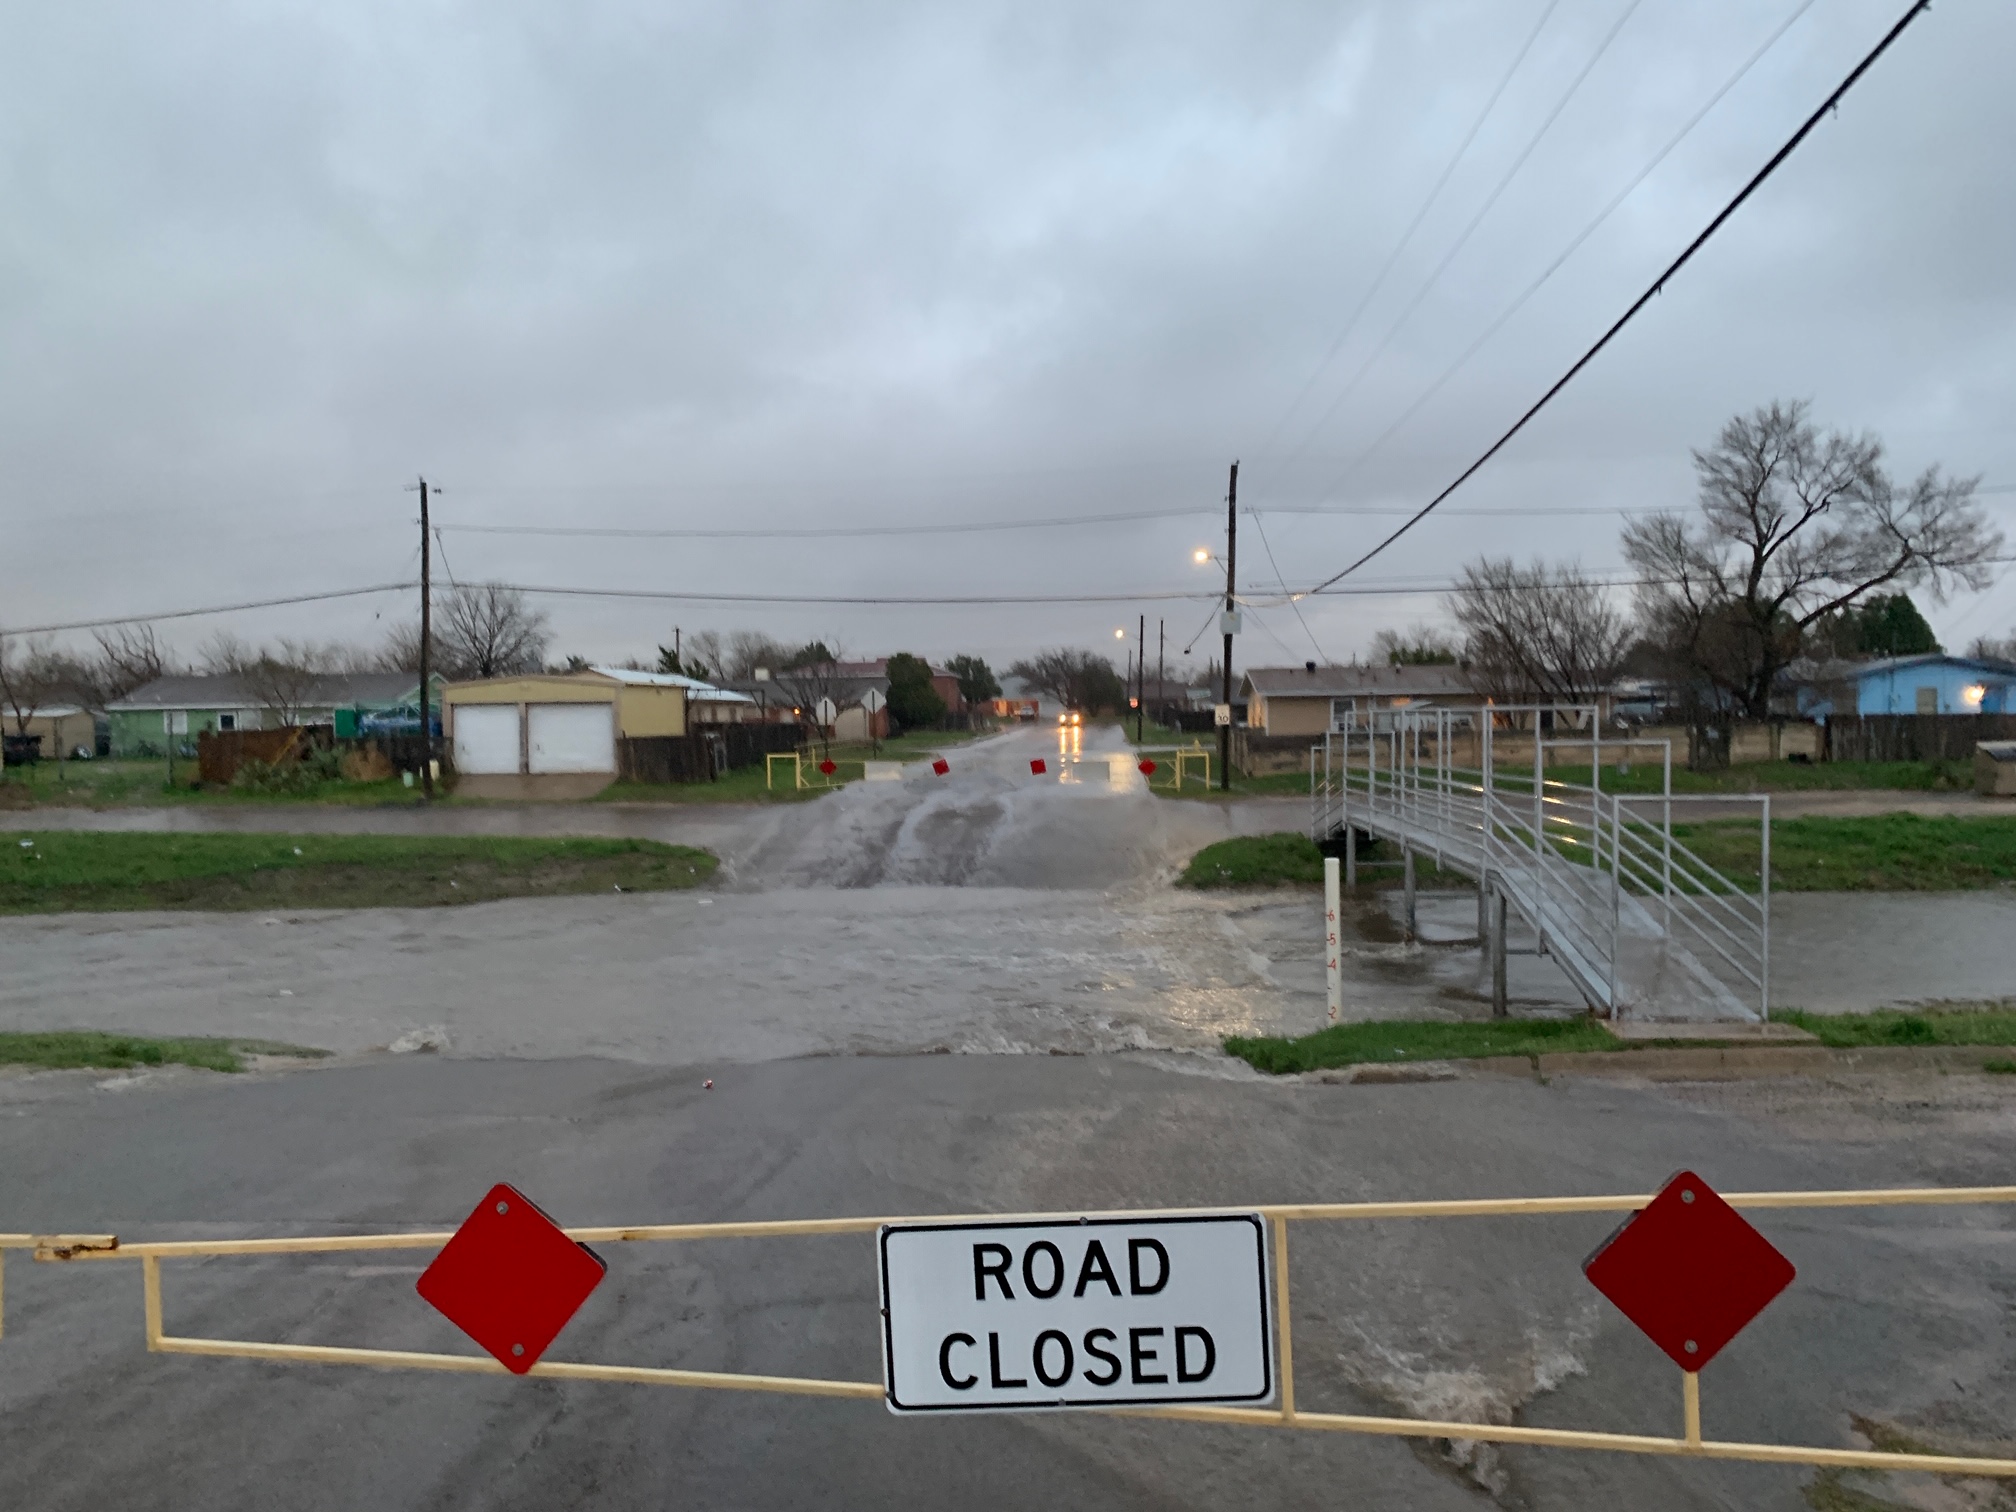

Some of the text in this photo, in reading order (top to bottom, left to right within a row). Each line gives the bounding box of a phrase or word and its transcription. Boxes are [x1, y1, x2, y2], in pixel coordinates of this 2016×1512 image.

[1328, 909, 1336, 922] 6
[1329, 933, 1337, 946] 5
[1329, 958, 1337, 970] 4
[1329, 1006, 1337, 1019] 2
[972, 1238, 1171, 1301] ROAD
[938, 1326, 1216, 1390] CLOSED
